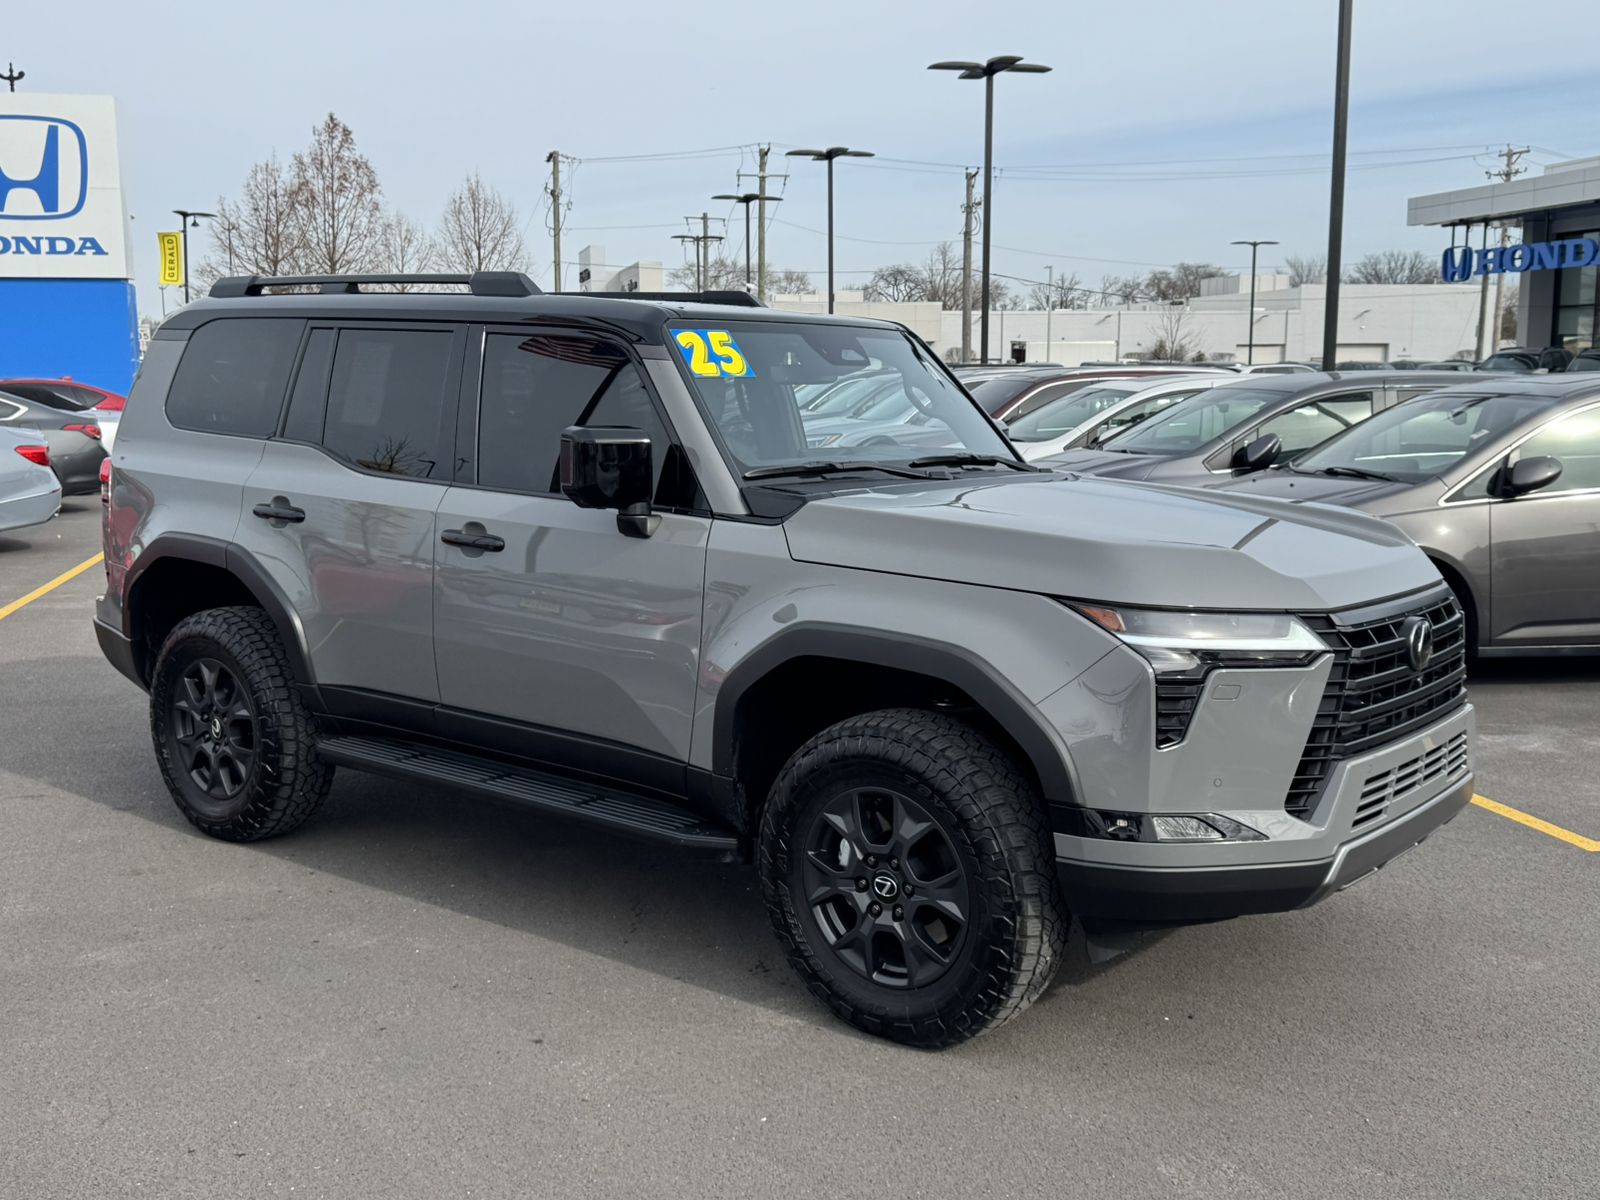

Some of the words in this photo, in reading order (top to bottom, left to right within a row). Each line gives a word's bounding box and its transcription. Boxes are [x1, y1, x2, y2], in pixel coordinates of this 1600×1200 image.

[167, 238, 175, 278] GERALD
[1473, 238, 1600, 275] HOND
[676, 331, 748, 377] 25
